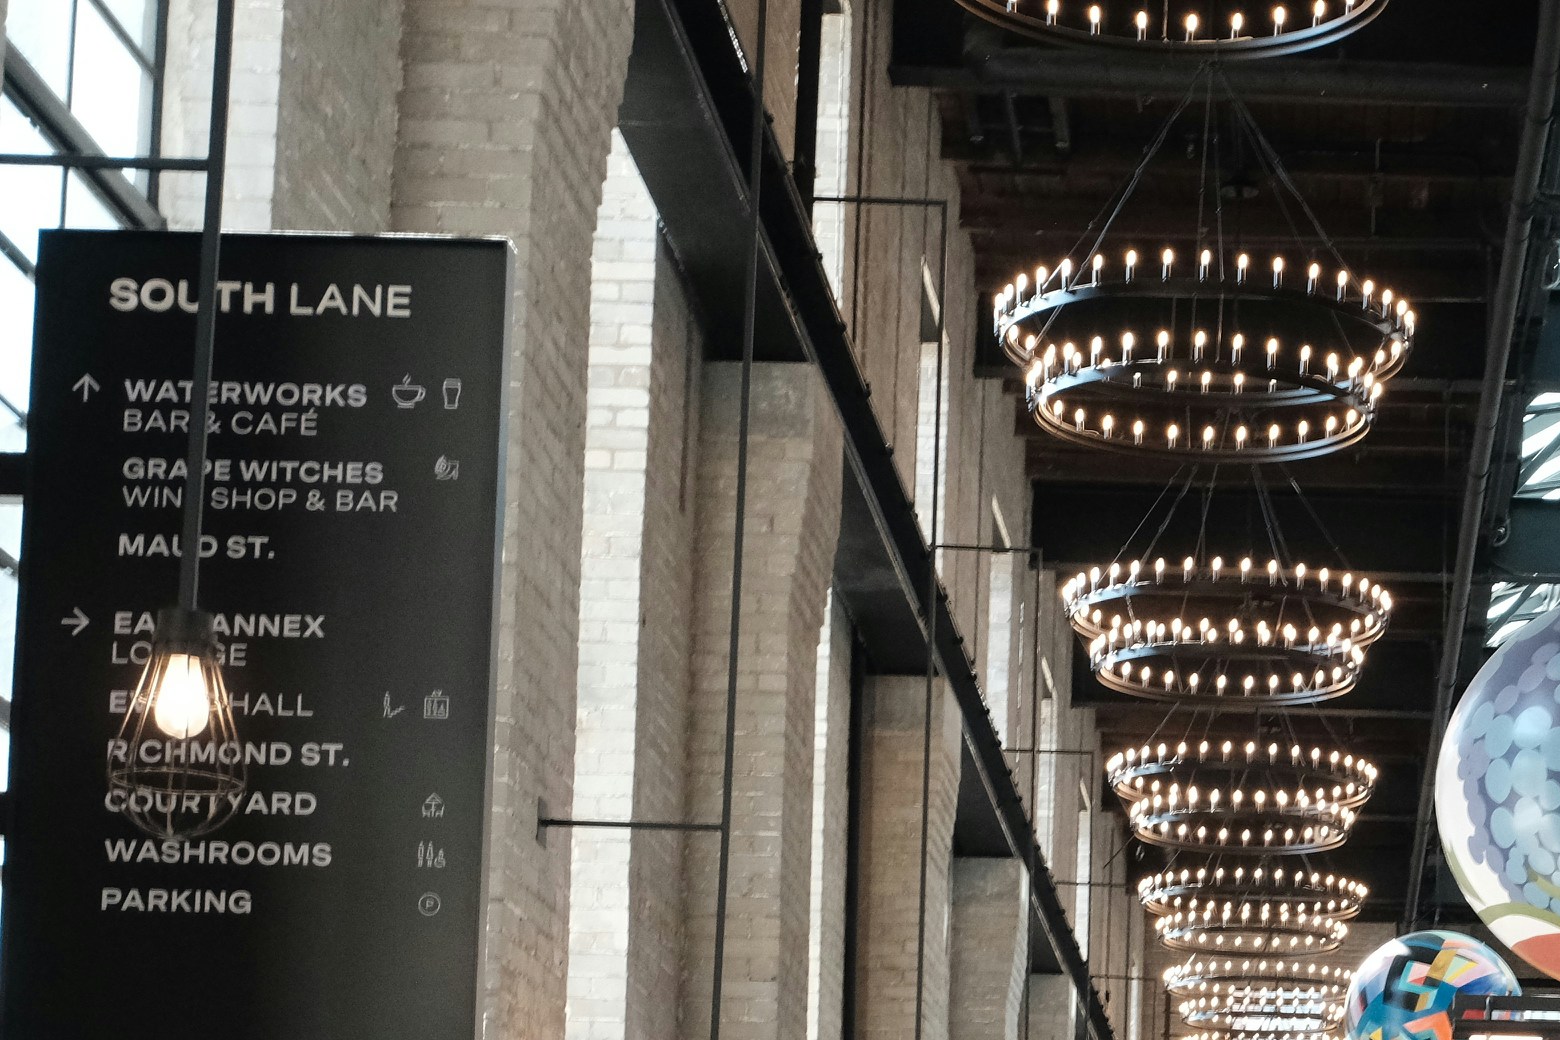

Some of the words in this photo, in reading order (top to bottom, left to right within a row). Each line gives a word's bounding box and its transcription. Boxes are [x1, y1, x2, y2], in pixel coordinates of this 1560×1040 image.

[289, 283, 412, 318] LANE
[124, 378, 368, 409] WATERWORKS
[123, 408, 190, 434] BAR
[231, 406, 318, 437] CAFÉ
[239, 459, 384, 485] WITCHES
[122, 485, 183, 508] WIN
[210, 486, 297, 510] SHOP
[305, 488, 326, 512] &
[335, 489, 399, 513] BAR
[226, 535, 275, 560] ST.
[212, 612, 325, 638] ANNEX
[228, 691, 314, 717] HALL
[300, 741, 350, 767] ST.
[104, 839, 332, 867] WASHROOMS
[100, 887, 253, 915] PARKING
